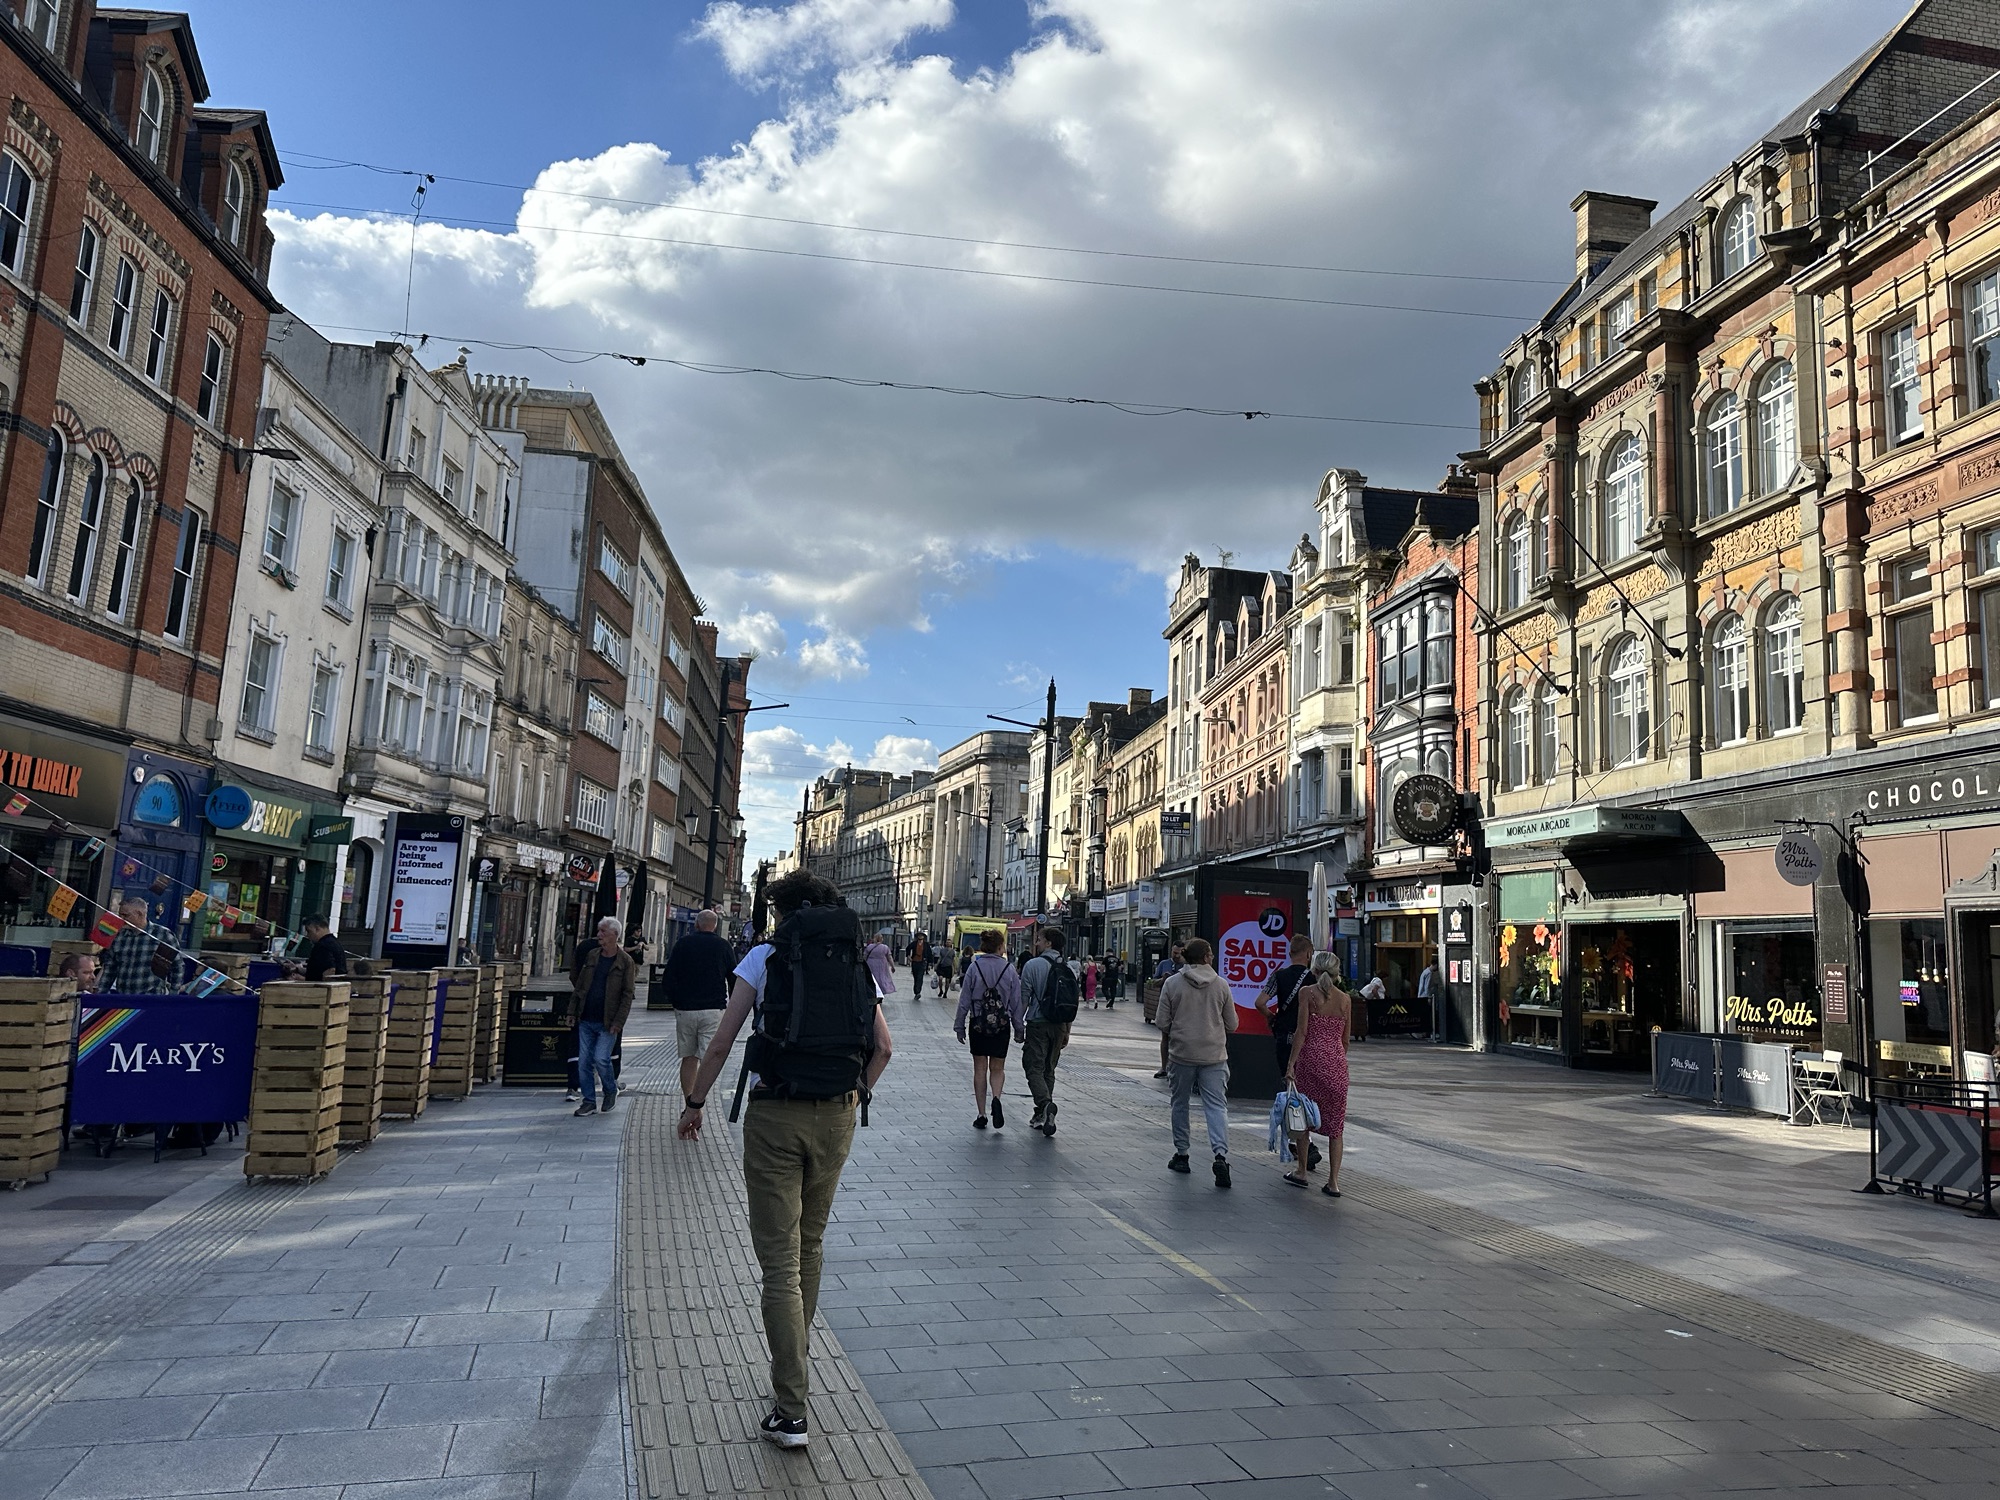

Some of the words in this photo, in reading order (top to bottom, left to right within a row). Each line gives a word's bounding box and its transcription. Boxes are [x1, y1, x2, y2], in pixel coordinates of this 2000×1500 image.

[9, 751, 33, 788] TO
[32, 757, 82, 798] WALK
[1407, 784, 1446, 799] PLAYHOUSE
[1867, 775, 2000, 810] CHOCOL
[152, 795, 162, 810] 90
[218, 802, 245, 812] FYEO
[242, 800, 301, 838] UBWAY
[1621, 812, 1657, 822] MORGAN
[313, 821, 349, 838] SUBWAY
[1506, 823, 1537, 837] MORGAN
[1539, 818, 1571, 831] ARCADE
[1624, 823, 1655, 831] ARCADE
[420, 831, 440, 840] global
[400, 843, 418, 851] Are
[419, 845, 438, 853] you
[1781, 841, 1809, 855] Mrs.
[399, 851, 427, 862] being
[1784, 854, 1817, 867] Potts
[398, 859, 443, 869] informed
[397, 868, 408, 876] or
[396, 876, 452, 886] influenced?
[1594, 891, 1621, 900] MORGAN
[1625, 889, 1651, 900] ARCADE
[390, 898, 404, 933] i
[1262, 914, 1284, 930] JD
[1224, 938, 1287, 960] SALE
[1223, 957, 1229, 965] TO
[1223, 965, 1229, 975] UP
[1227, 957, 1285, 983] 50%
[1725, 995, 1764, 1022] Mrs.
[1767, 997, 1818, 1026] Potts
[1780, 1029, 1804, 1037] HOUSE
[1684, 1059, 1699, 1071] Potts
[1752, 1069, 1771, 1082] Potts
